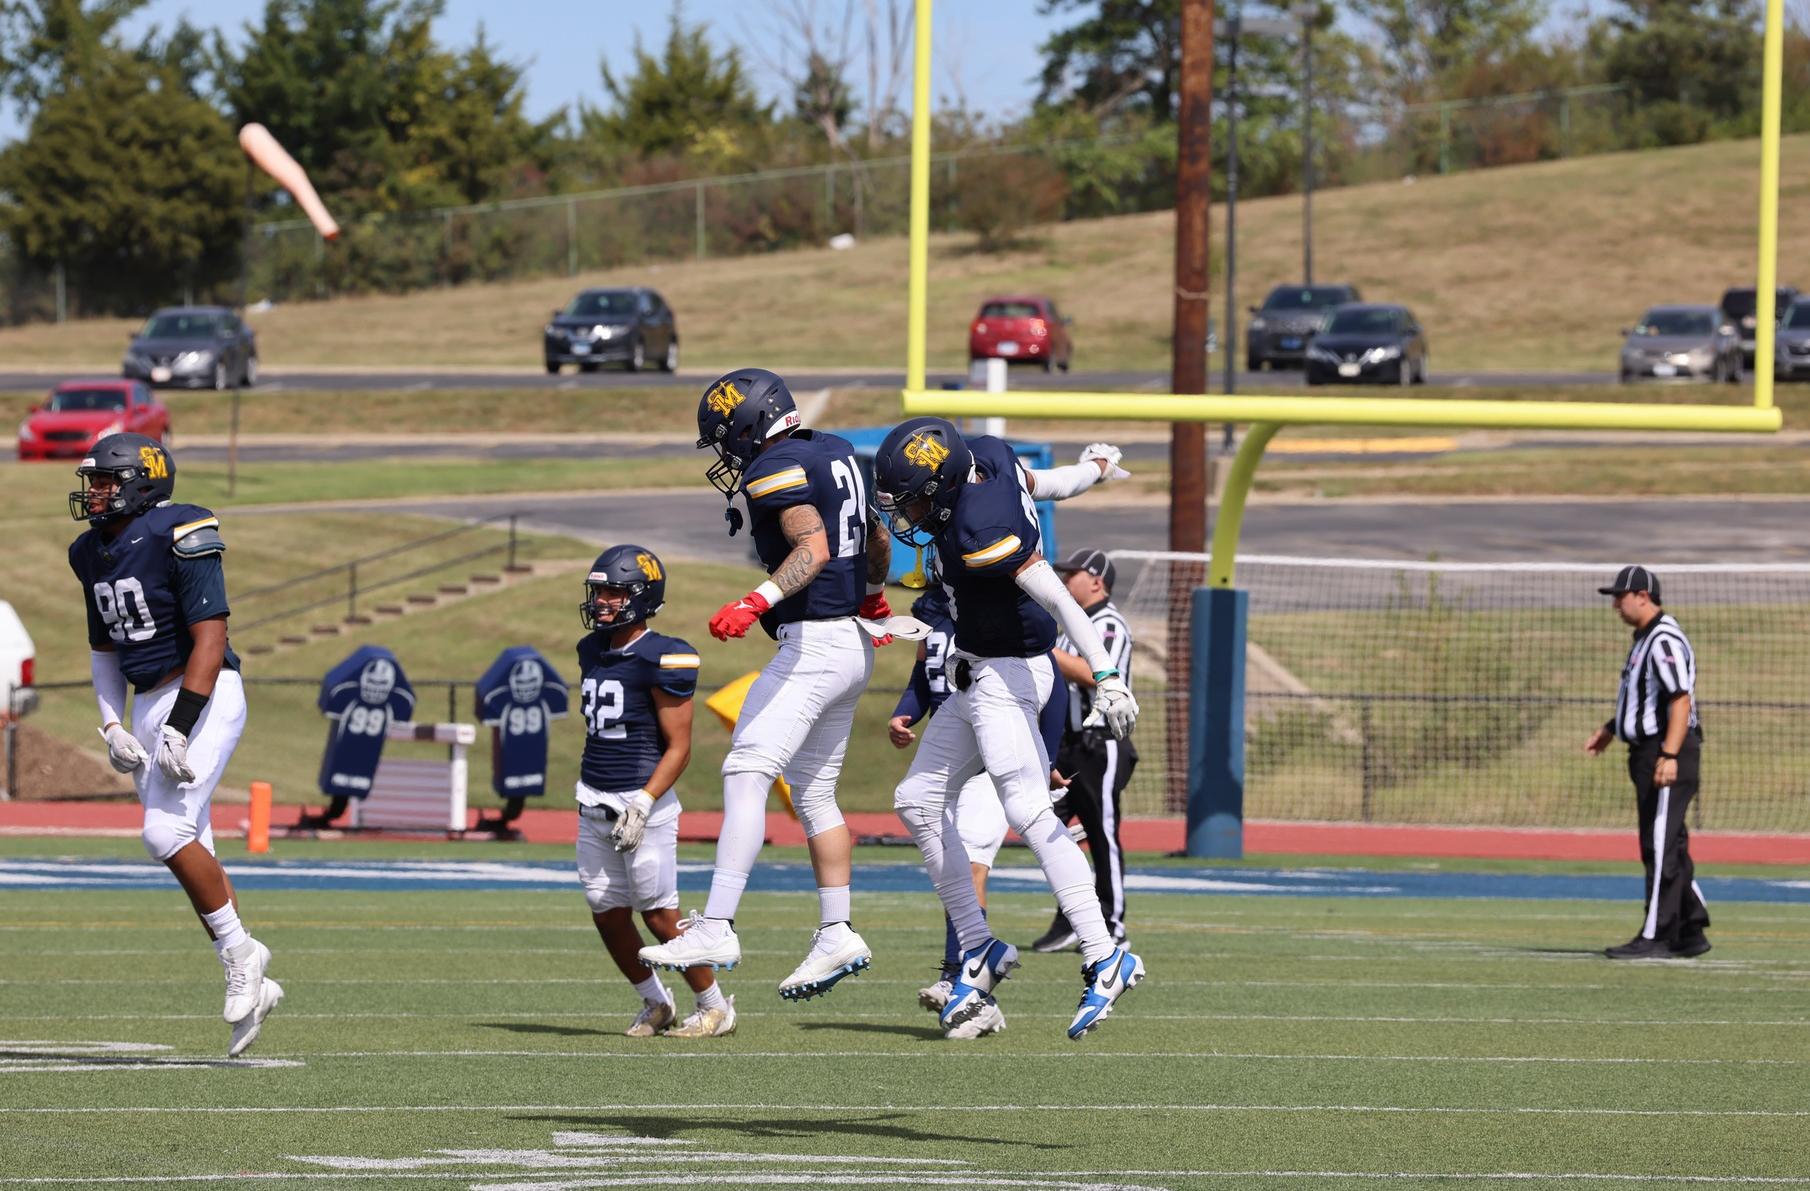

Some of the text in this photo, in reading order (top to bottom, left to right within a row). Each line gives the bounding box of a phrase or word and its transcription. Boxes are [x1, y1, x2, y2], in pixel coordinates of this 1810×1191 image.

[94, 577, 157, 641] 90
[348, 706, 387, 737] 99
[508, 706, 544, 736] 99
[581, 678, 627, 739] 32
